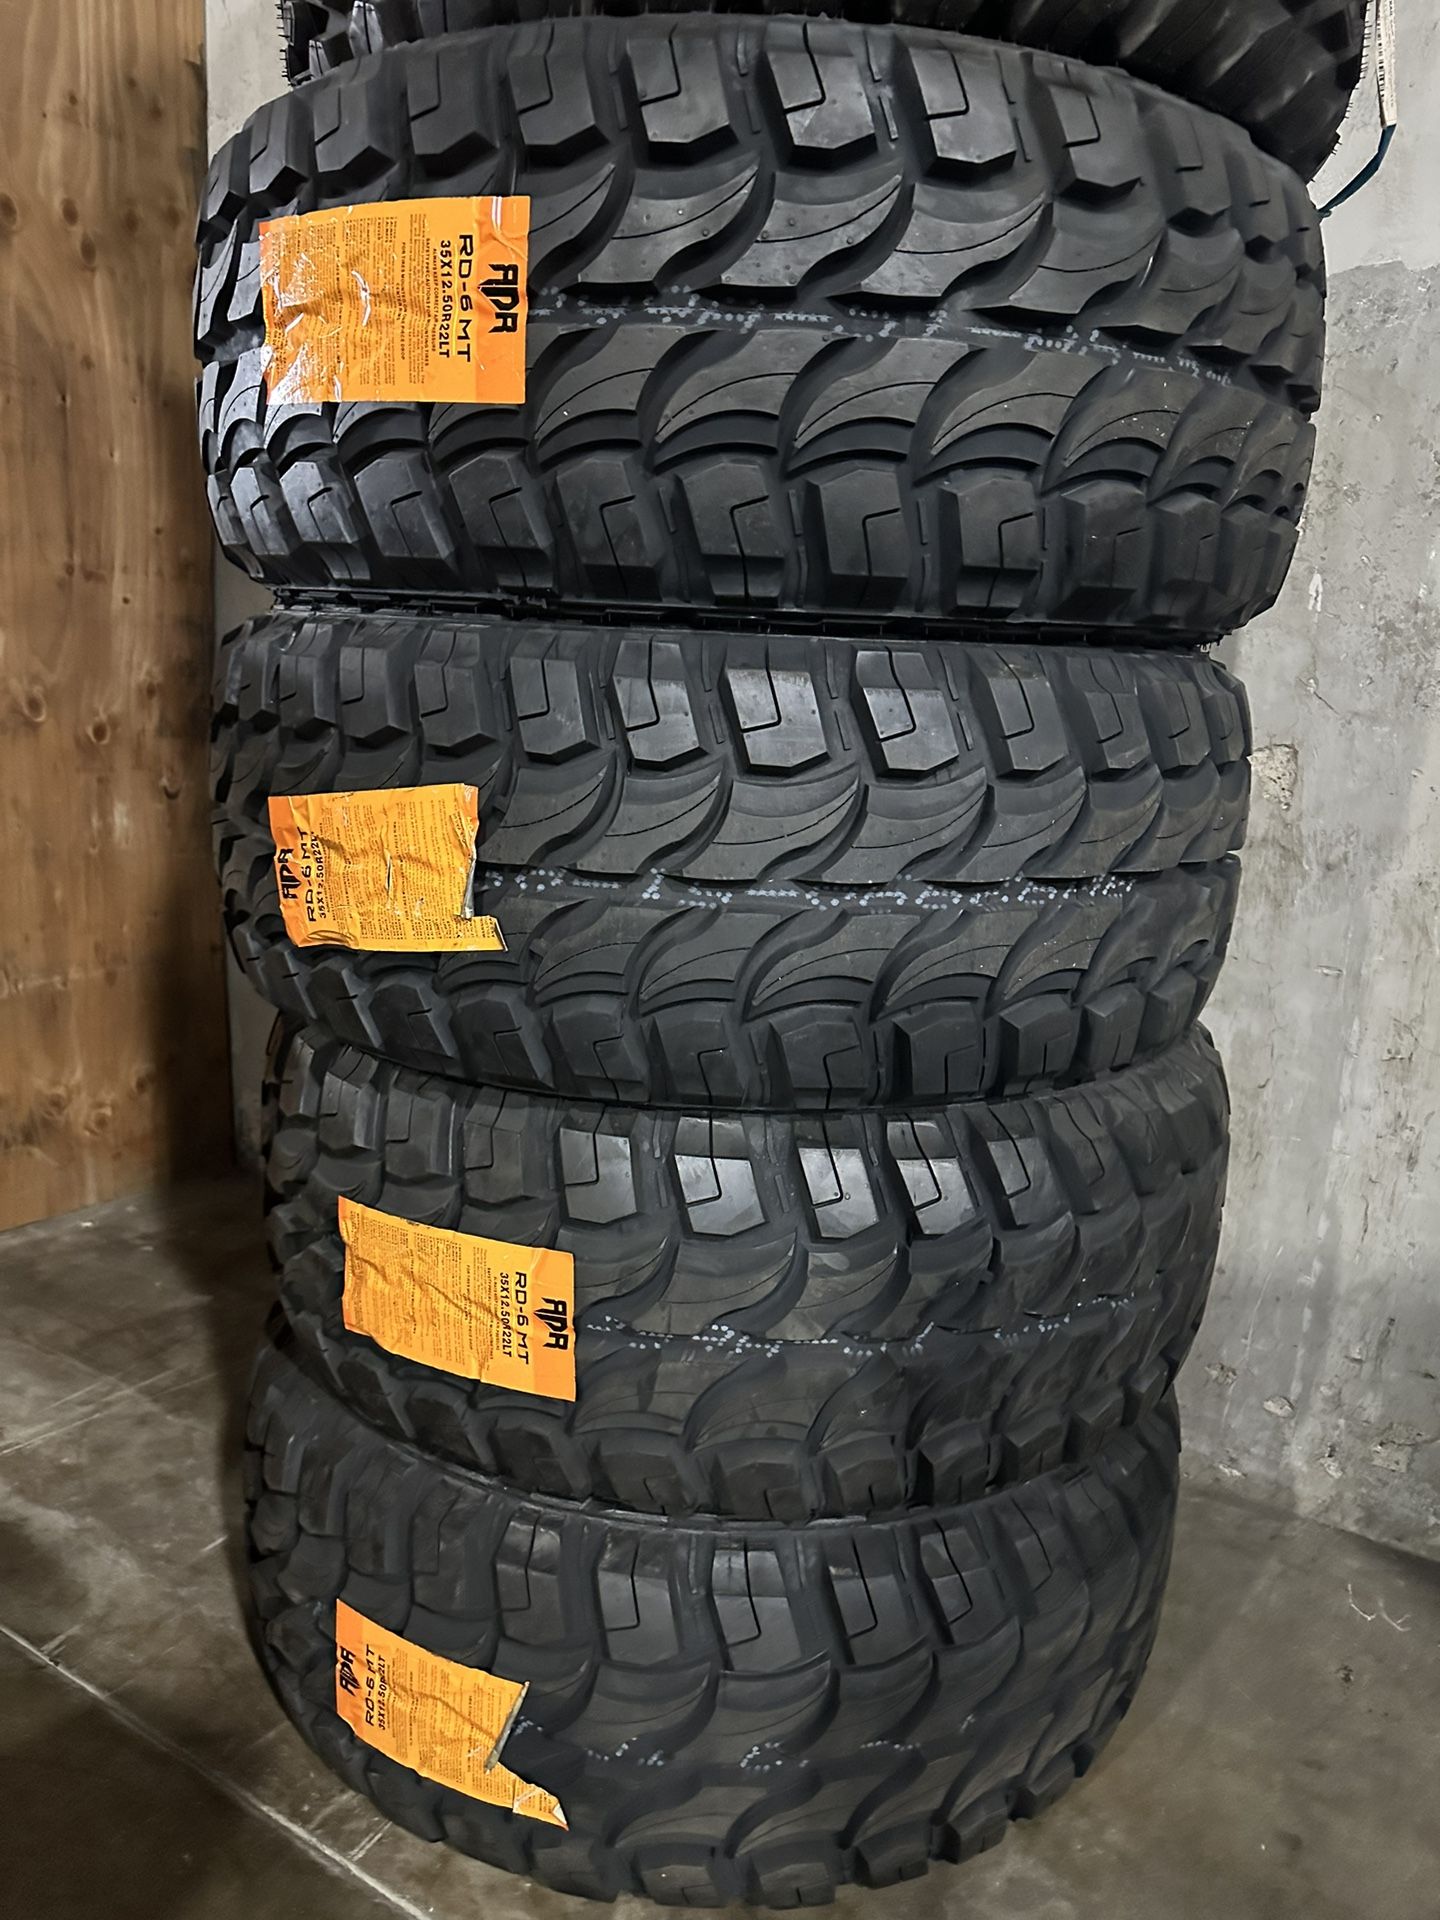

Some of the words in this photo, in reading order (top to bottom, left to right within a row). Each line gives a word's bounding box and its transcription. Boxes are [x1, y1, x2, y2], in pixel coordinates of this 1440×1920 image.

[439, 239, 453, 358] 35X12.50R22LT
[459, 234, 473, 311] RD-6
[477, 264, 520, 333] ADR
[457, 319, 473, 362] MT
[297, 826, 310, 859] MT
[277, 848, 301, 899] ADR
[301, 866, 316, 922] RD-6
[499, 1272, 512, 1357] 35X12.50R22LT
[515, 1271, 529, 1326] RD-6
[533, 1297, 569, 1350] ADR
[517, 1331, 529, 1364] MT
[339, 1645, 362, 1697] ADR
[366, 1644, 376, 1675] MT
[365, 1676, 374, 1727] RD-6
